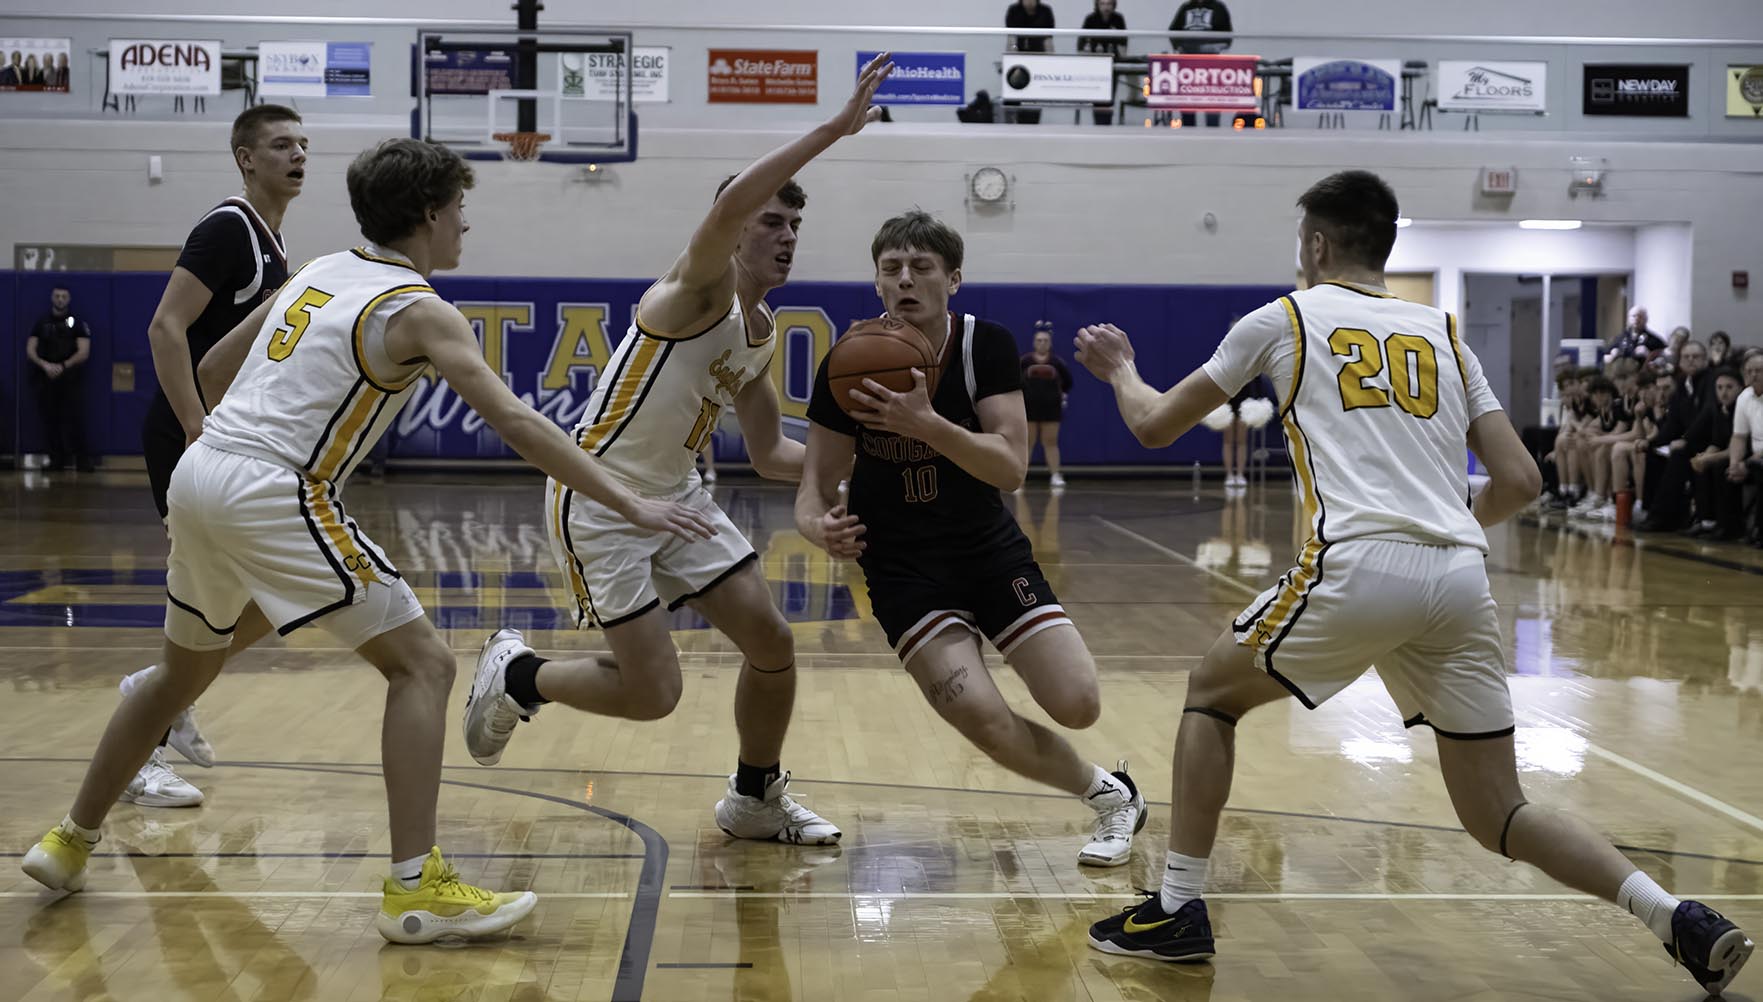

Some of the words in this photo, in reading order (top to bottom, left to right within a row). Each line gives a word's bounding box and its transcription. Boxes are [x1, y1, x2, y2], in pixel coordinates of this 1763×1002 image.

[121, 43, 210, 71] ADENA
[589, 54, 663, 69] STRAEGIC
[1152, 61, 1252, 93] HORTON
[1469, 71, 1489, 85] My
[1618, 79, 1650, 90] NEW
[1651, 79, 1677, 90] DAY
[1180, 85, 1251, 94] CONSTRUCTION
[1464, 84, 1533, 96] FLOORS
[267, 286, 335, 362] 5
[1327, 327, 1439, 419] 20
[902, 465, 938, 502] 10
[343, 552, 371, 572] CC
[1012, 576, 1037, 606] C
